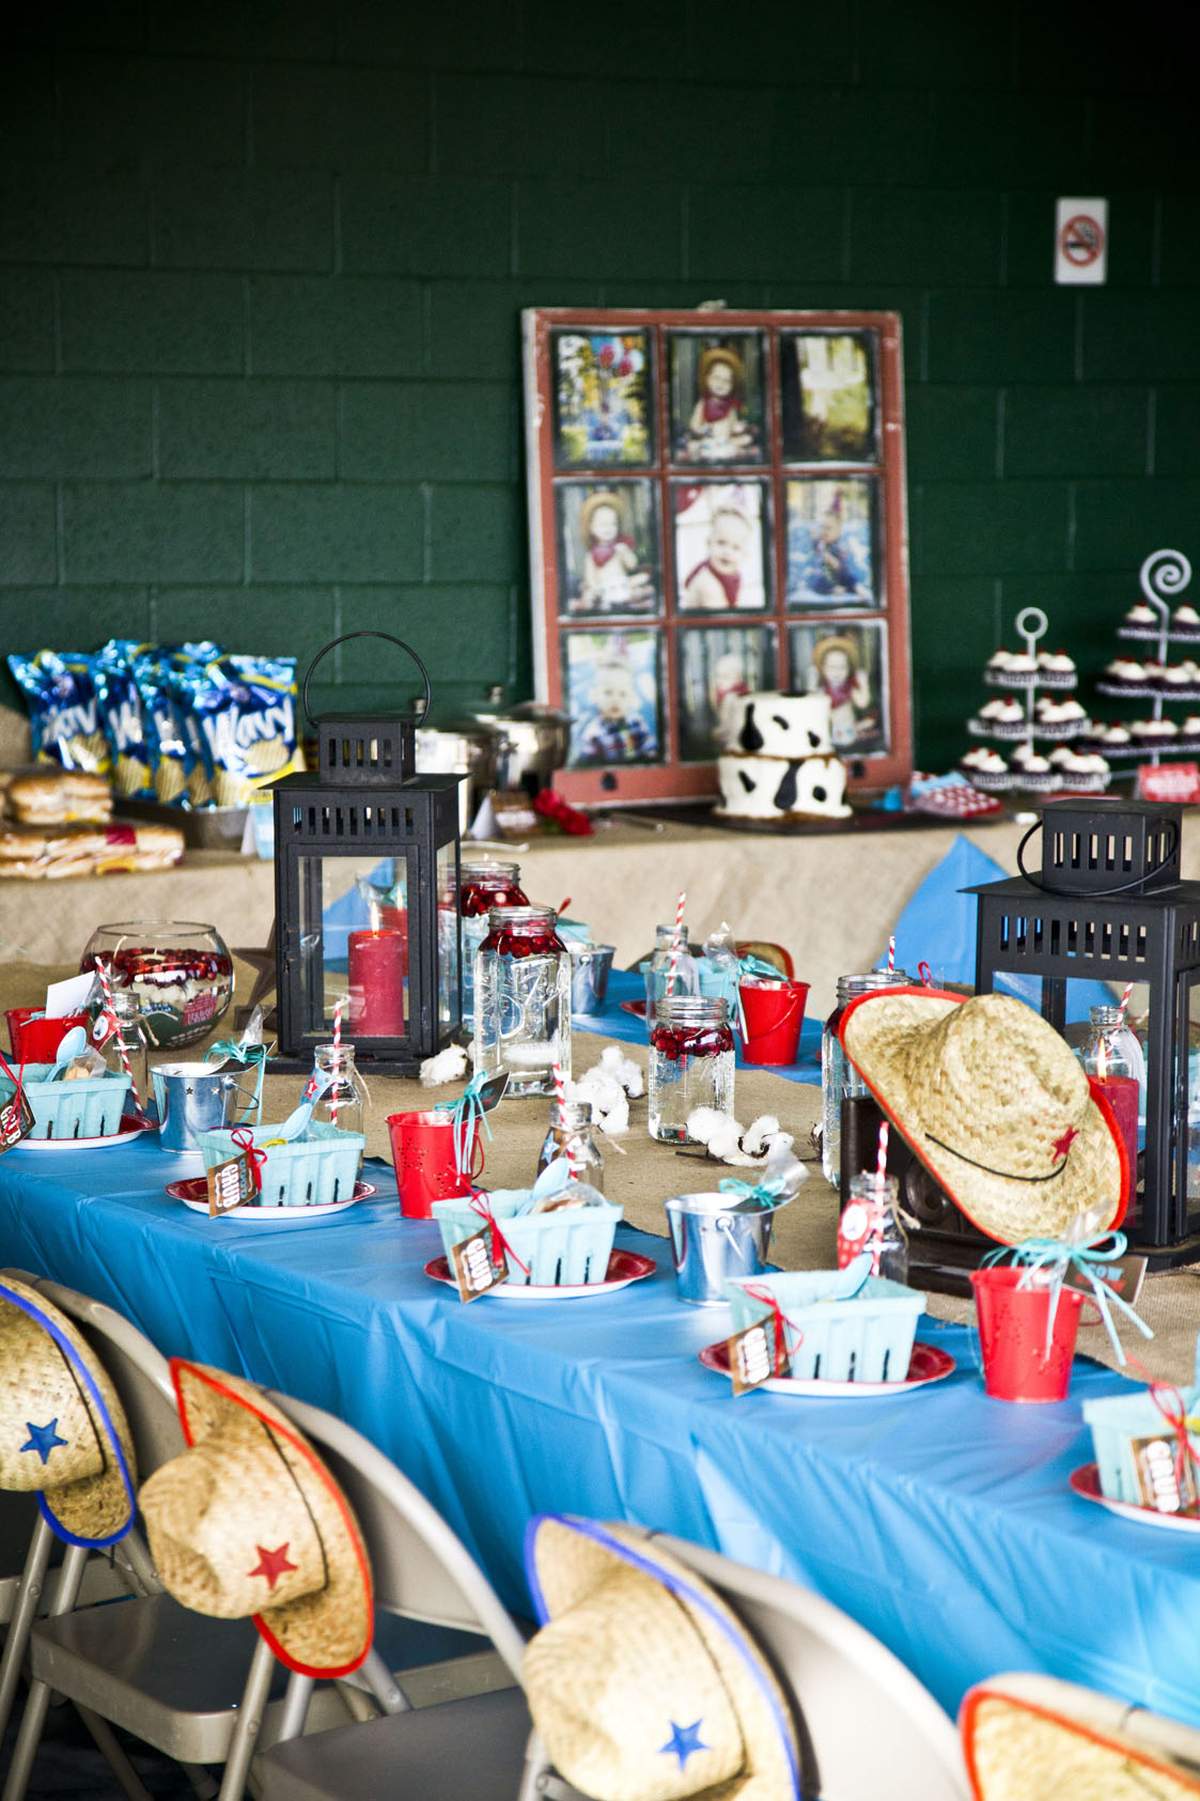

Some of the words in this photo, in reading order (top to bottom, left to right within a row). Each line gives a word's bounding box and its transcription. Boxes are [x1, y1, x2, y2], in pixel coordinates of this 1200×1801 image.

[202, 695, 294, 767] Wavy
[221, 1163, 241, 1208] GRUB
[466, 1237, 493, 1291] GRUB
